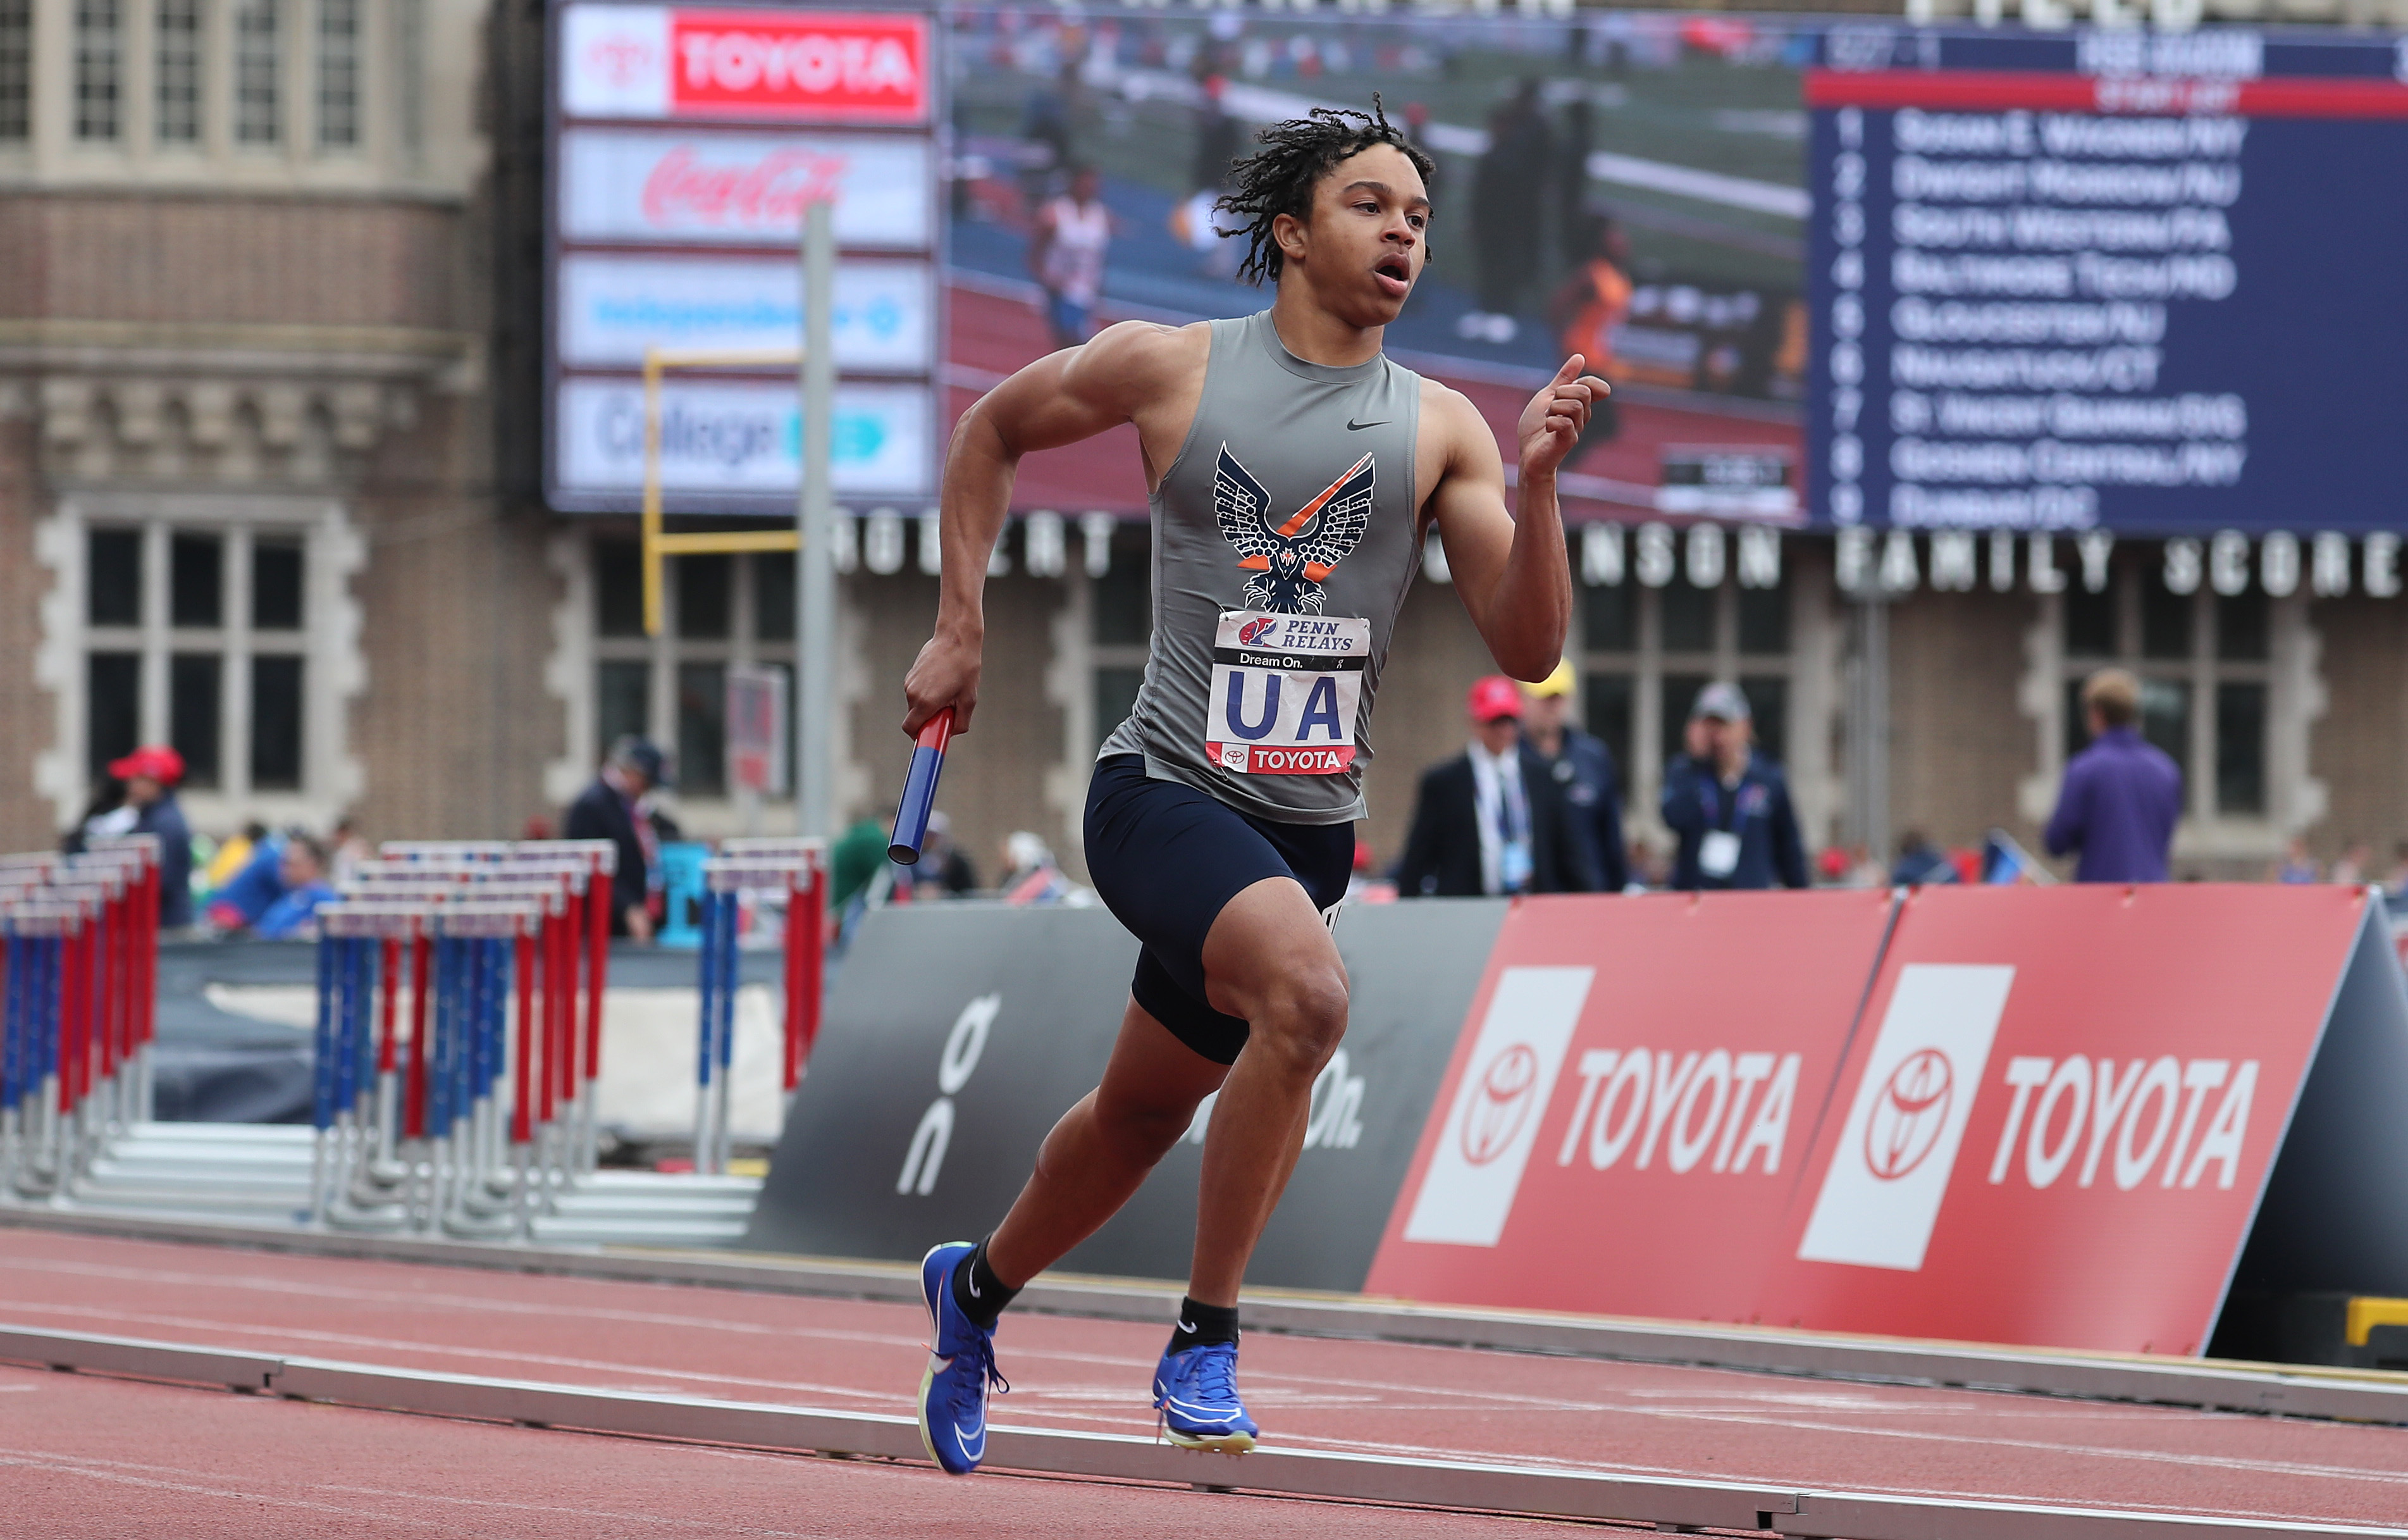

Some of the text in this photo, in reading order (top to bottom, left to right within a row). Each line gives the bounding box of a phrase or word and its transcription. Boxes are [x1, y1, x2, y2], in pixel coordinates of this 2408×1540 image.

[681, 34, 914, 92] TOYOTA
[1836, 529, 2115, 593] FAMILY
[2164, 529, 2403, 598] SCORE
[1283, 636, 1354, 650] RELAYS
[1287, 619, 1340, 635] PENN
[1240, 652, 1304, 669] Dream On.
[1255, 750, 1342, 769] TOYOTA
[1557, 1046, 1803, 1175] TOYOTA
[1987, 1055, 2260, 1189] TOYOTA
